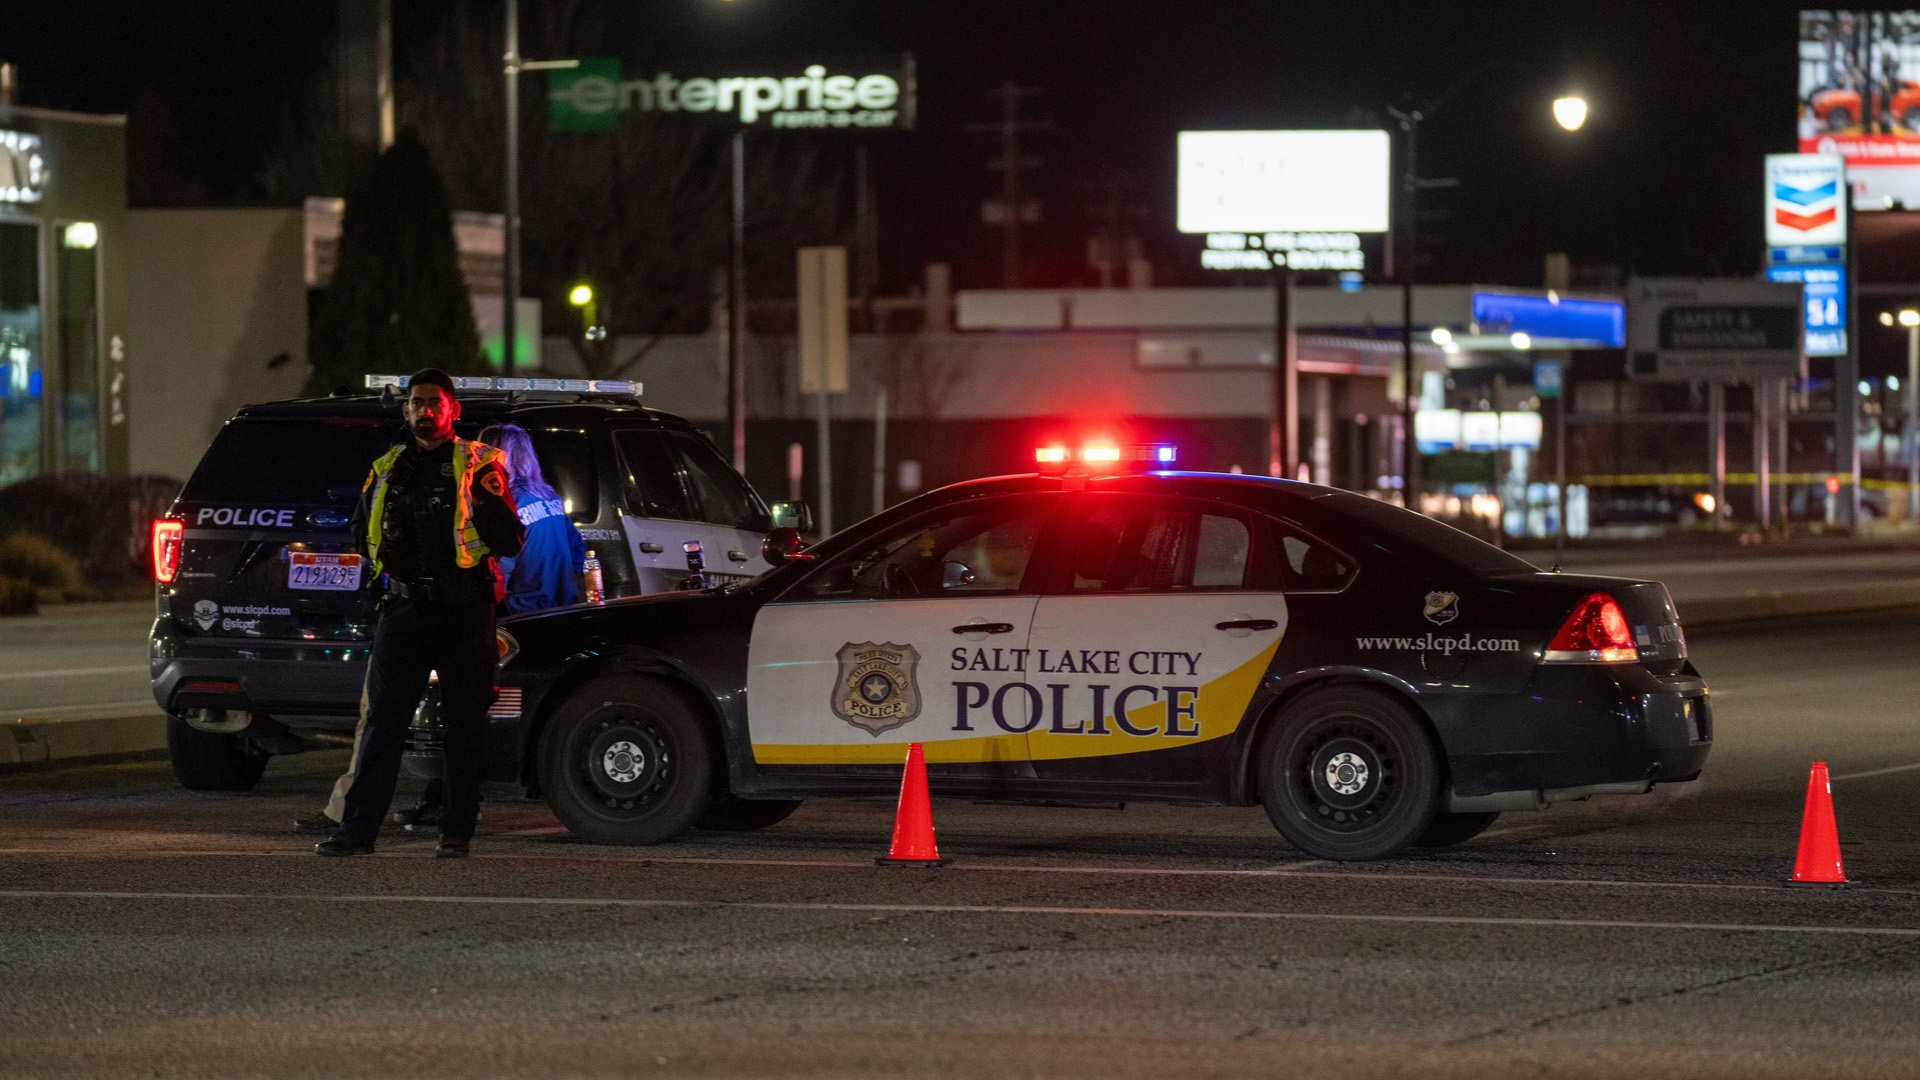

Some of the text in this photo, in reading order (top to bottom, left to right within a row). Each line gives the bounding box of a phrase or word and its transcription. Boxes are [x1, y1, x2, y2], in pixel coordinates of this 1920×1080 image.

[566, 64, 899, 124] enterprise
[771, 110, 897, 129] rent-a-car
[197, 507, 297, 528] POLICE
[516, 500, 551, 526] CRIME
[294, 565, 348, 585] 219129
[222, 604, 291, 617] www.slcpd.com
[222, 618, 255, 631] @slcpd
[1356, 633, 1520, 656] www.slcpd.com
[853, 662, 902, 680] SALT LAKE CITY
[951, 647, 1203, 676] SALT LAKE CITY
[850, 700, 902, 717] POLICE
[951, 680, 1201, 738] POLICE
